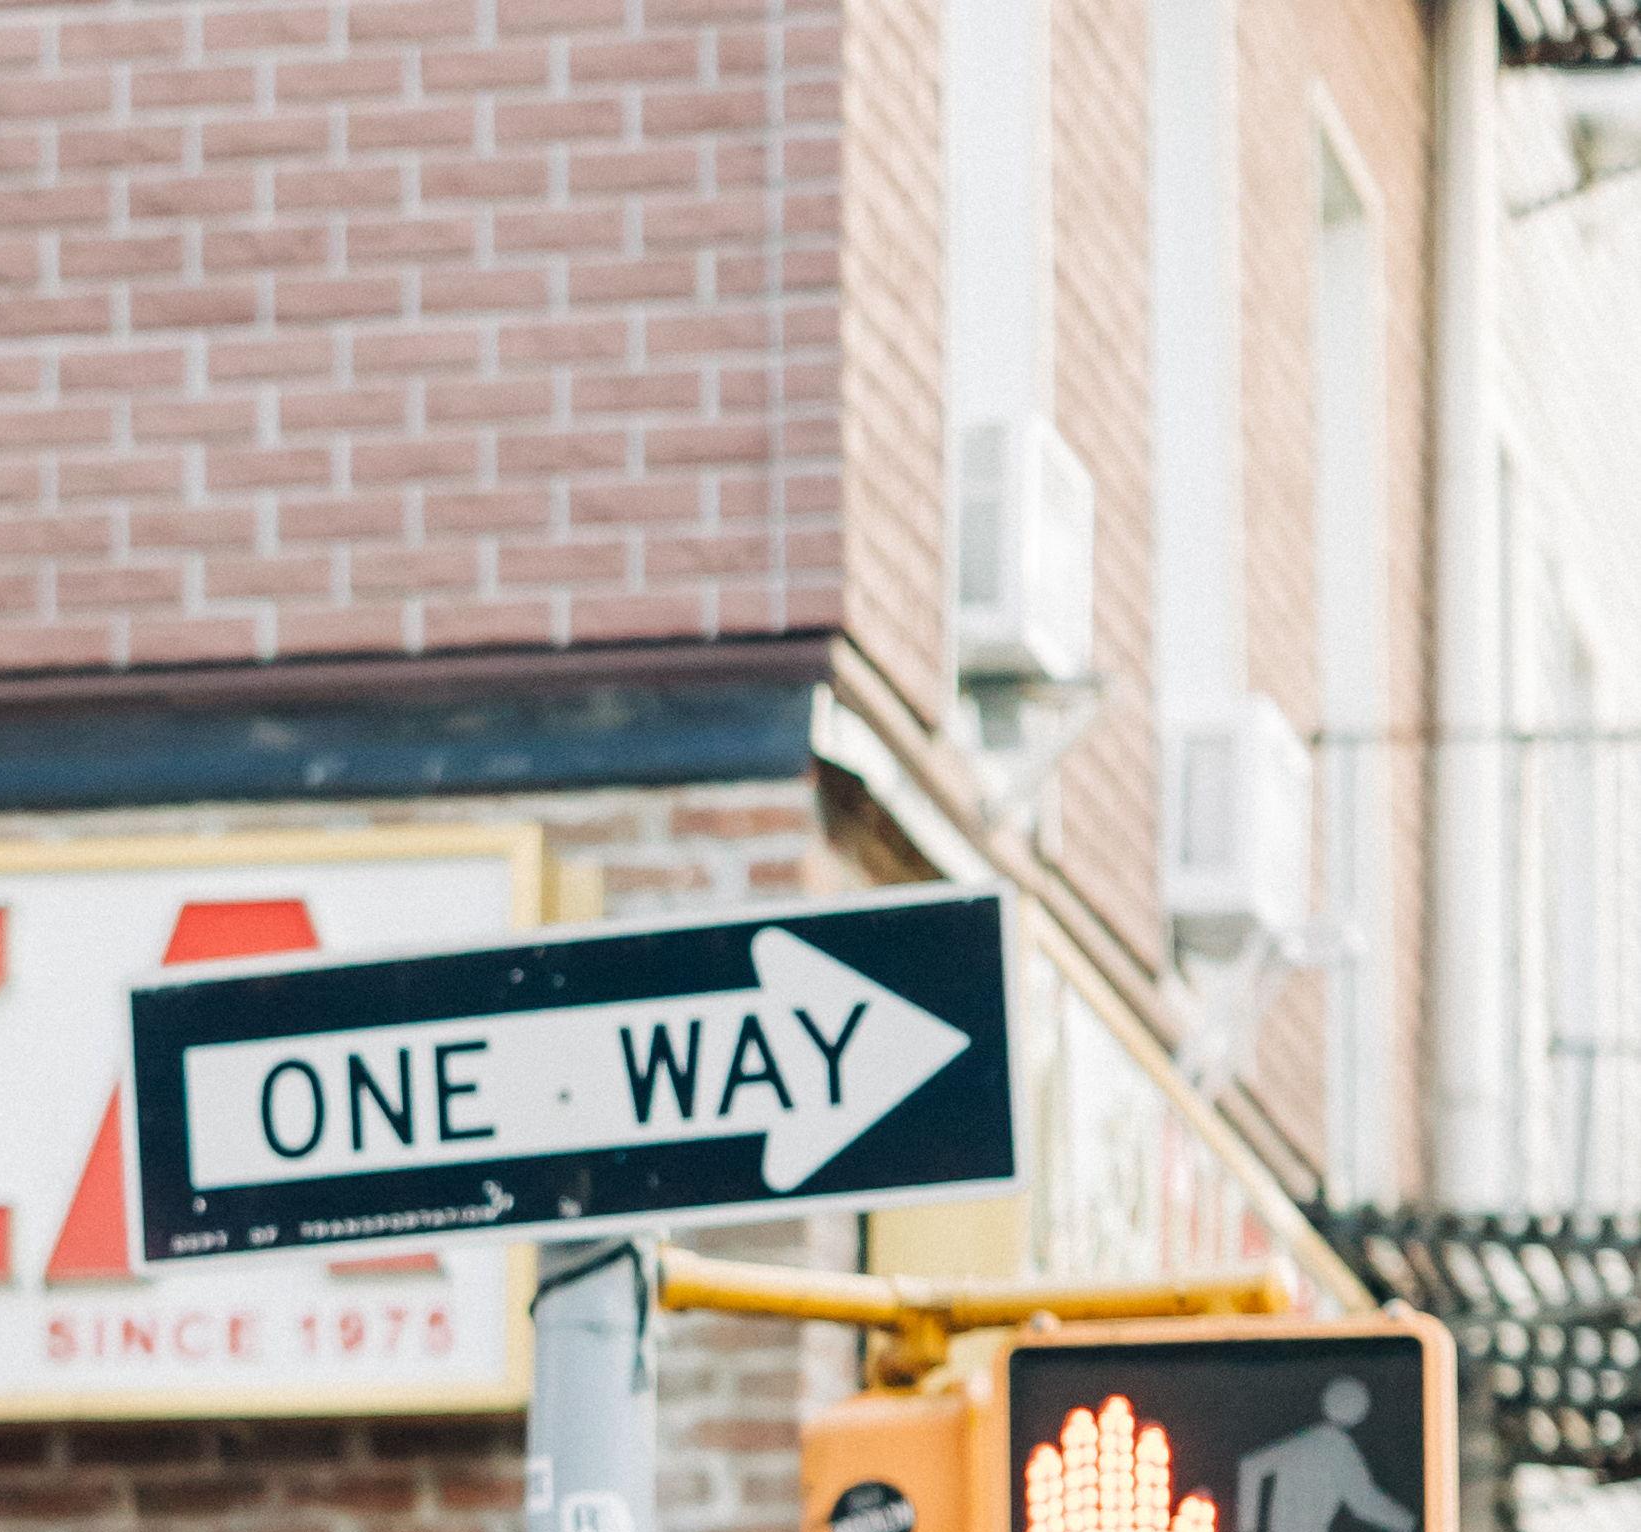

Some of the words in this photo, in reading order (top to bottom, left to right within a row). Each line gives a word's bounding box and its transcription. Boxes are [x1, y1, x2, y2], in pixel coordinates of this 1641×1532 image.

[261, 1040, 496, 1159] ONE
[619, 1002, 870, 1125] WAY
[46, 1310, 262, 1361] SINCE
[299, 1304, 454, 1357] 1975
